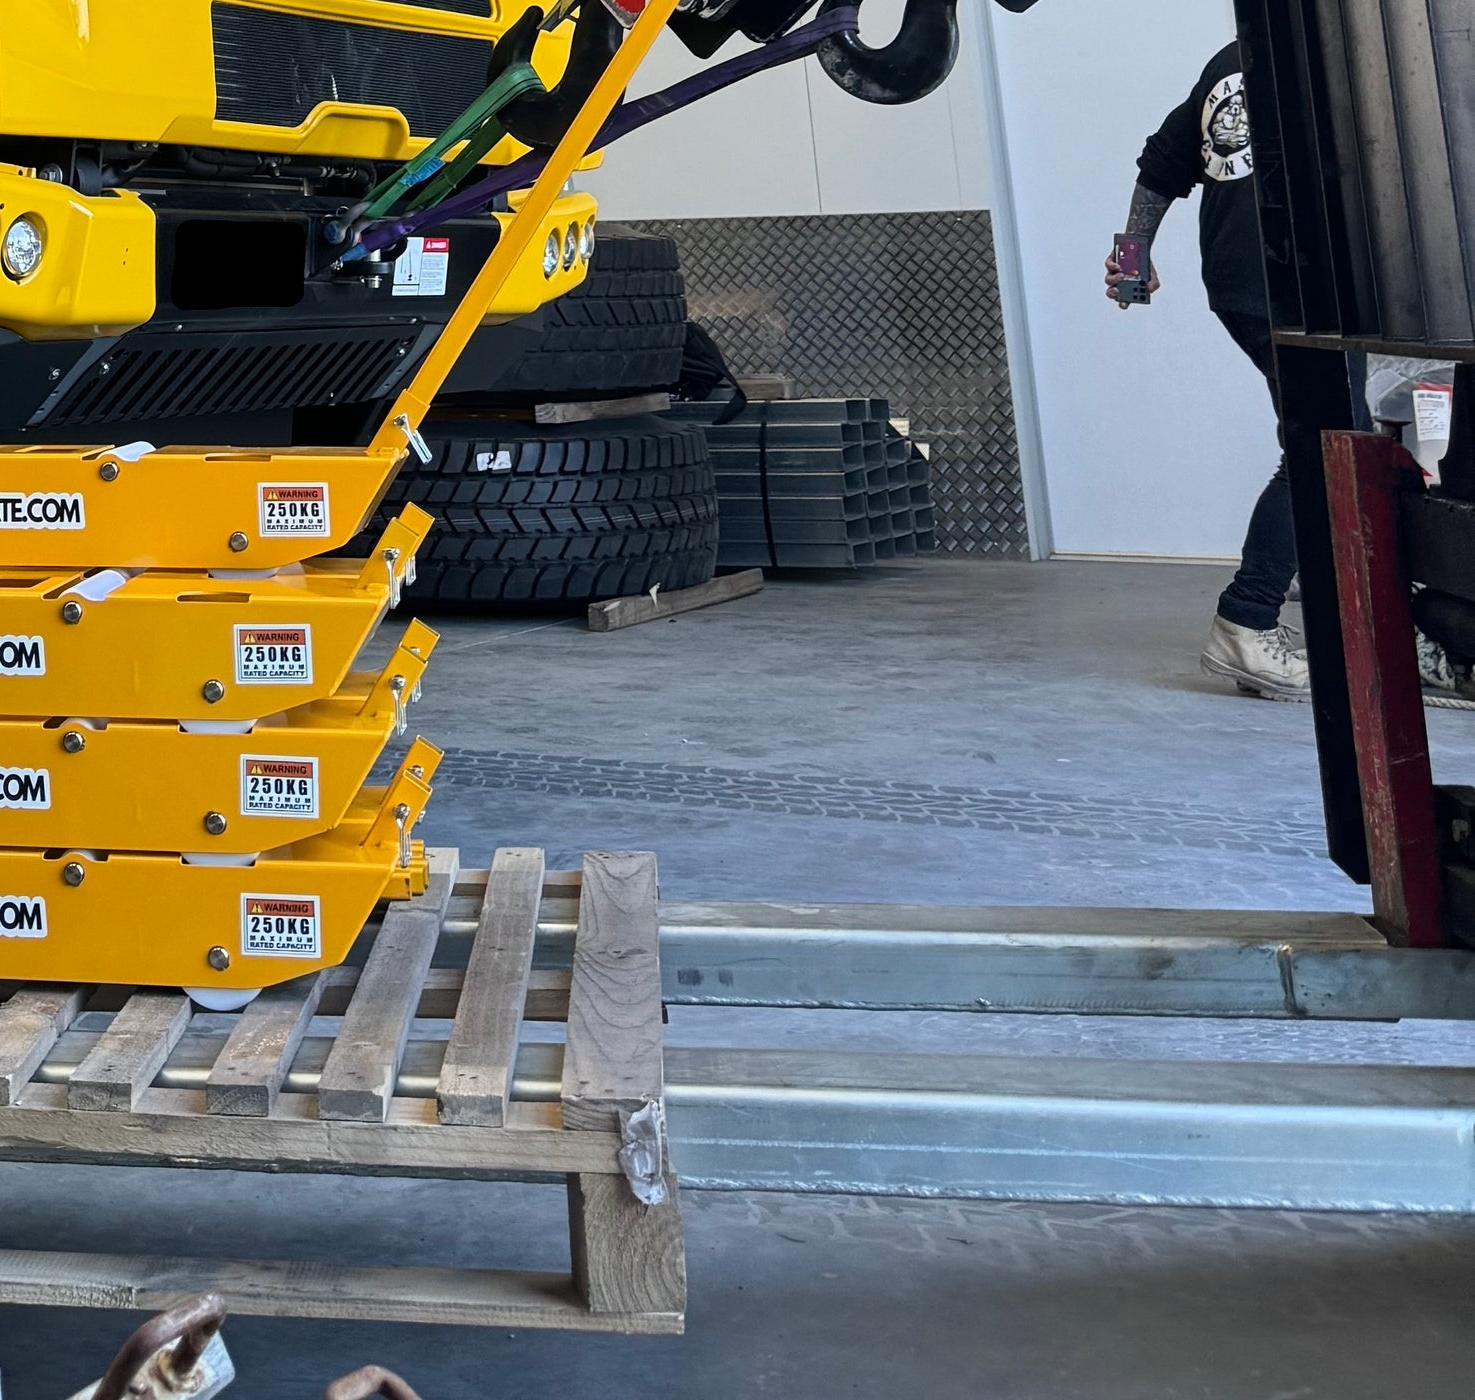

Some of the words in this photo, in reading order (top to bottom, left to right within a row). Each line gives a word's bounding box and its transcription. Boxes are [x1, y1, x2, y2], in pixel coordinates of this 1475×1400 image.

[279, 490, 318, 498] WARNING
[267, 503, 319, 517] 250KG
[257, 633, 299, 641] WARNING
[245, 646, 301, 662] 250KG
[263, 764, 307, 774] WARNING
[250, 777, 308, 795] 250KG
[249, 795, 311, 803] MAXIMUM
[264, 903, 308, 913] WARNING
[251, 917, 310, 934] 250KG
[250, 935, 313, 943] MAXIMUM
[276, 942, 313, 950] CAPACITY
